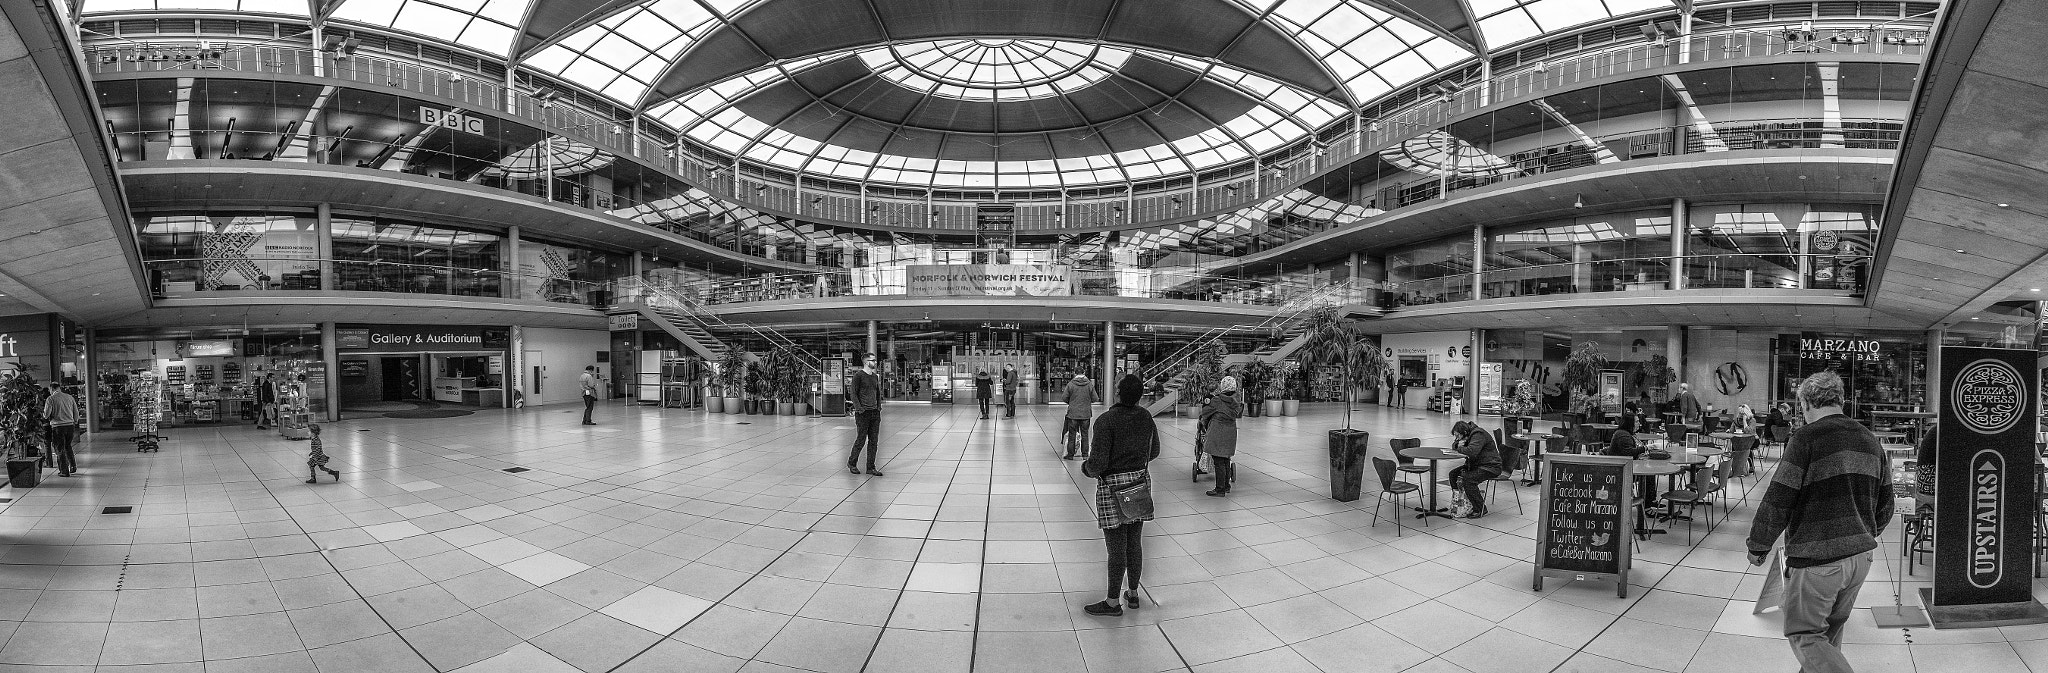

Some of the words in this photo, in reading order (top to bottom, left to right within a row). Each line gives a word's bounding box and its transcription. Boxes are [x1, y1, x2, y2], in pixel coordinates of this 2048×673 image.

[425, 109, 481, 133] BBC
[204, 231, 221, 247] DISS
[912, 274, 958, 282] NORFOLK
[969, 274, 1017, 282] NORWICH
[371, 333, 412, 345] Gallery
[415, 333, 423, 343] &
[426, 333, 482, 343] Auditorium
[1801, 339, 1880, 353] MARZANO
[951, 345, 1029, 366] Library
[1857, 353, 1880, 361] BAR
[1973, 386, 2006, 395] PIZZA
[1963, 394, 2015, 404] EXPRESS
[1555, 467, 1574, 482] Like
[1583, 473, 1593, 483] us
[1605, 474, 1616, 484] on
[1553, 498, 1572, 513] Cafe
[1575, 499, 1588, 514] Bar
[1589, 500, 1618, 515] Marzano
[1585, 519, 1596, 530] us
[1603, 520, 1614, 531] on
[1974, 473, 1998, 576] UPSTAIRS
[1551, 529, 1584, 545] Twitter
